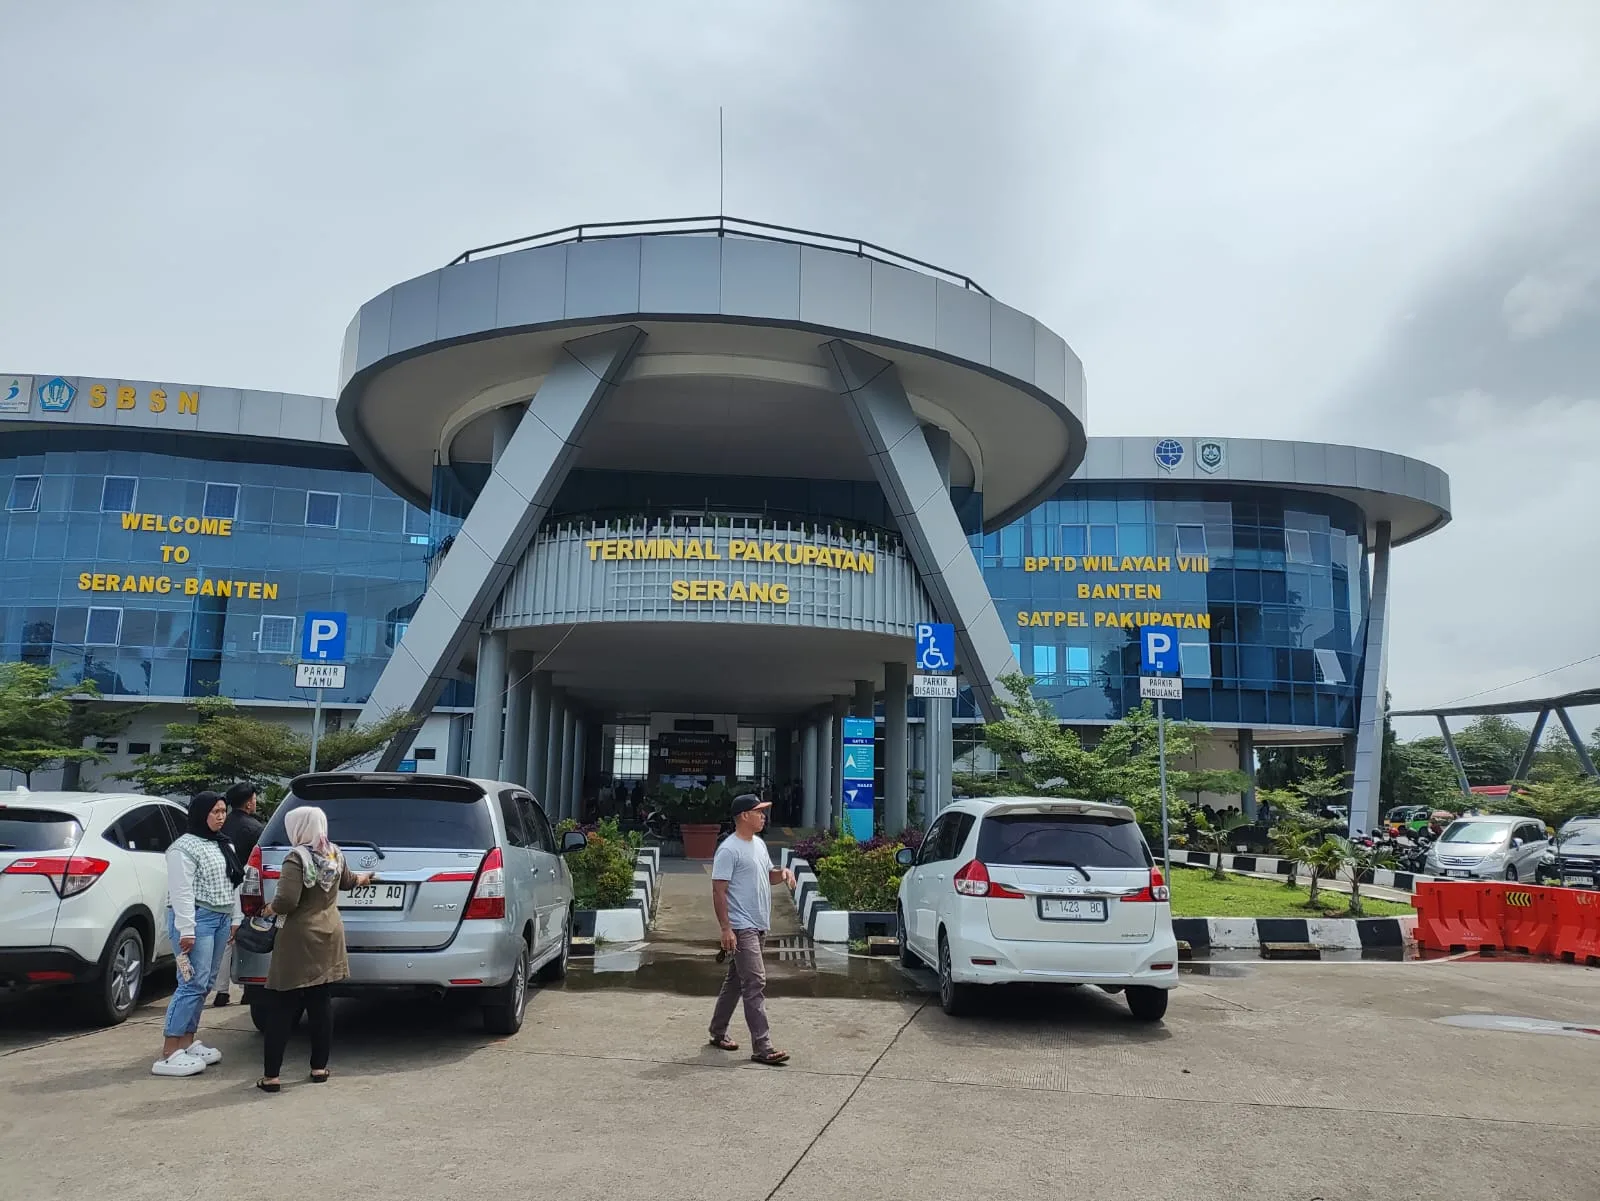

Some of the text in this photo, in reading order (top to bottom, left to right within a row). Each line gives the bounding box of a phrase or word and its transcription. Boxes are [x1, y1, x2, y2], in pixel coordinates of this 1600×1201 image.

[89, 383, 199, 415] SBSN
[121, 512, 233, 536] WELCOME
[160, 545, 190, 564] TO
[586, 539, 875, 574] TERMINAL PAKUPATAN
[1024, 556, 1210, 573] BPTD WILAYAH VIII
[77, 572, 279, 600] SERANG-BANTEN
[671, 580, 790, 604] SERANG
[1077, 583, 1161, 600] BANTEN
[1017, 611, 1211, 630] SATPEL PAKUPATAN
[309, 619, 339, 653] P
[918, 624, 933, 645] P
[1147, 632, 1171, 665] P
[304, 666, 339, 677] PARKIR
[308, 677, 333, 687] TAMU
[923, 677, 948, 686] PARKIR
[1149, 679, 1173, 688] PARKIR
[915, 686, 956, 697] DISABILITAS
[1142, 688, 1181, 698] AMBULANCE
[347, 886, 402, 899] 1273 AQ
[1044, 900, 1050, 912] A
[1060, 900, 1080, 913] 1423
